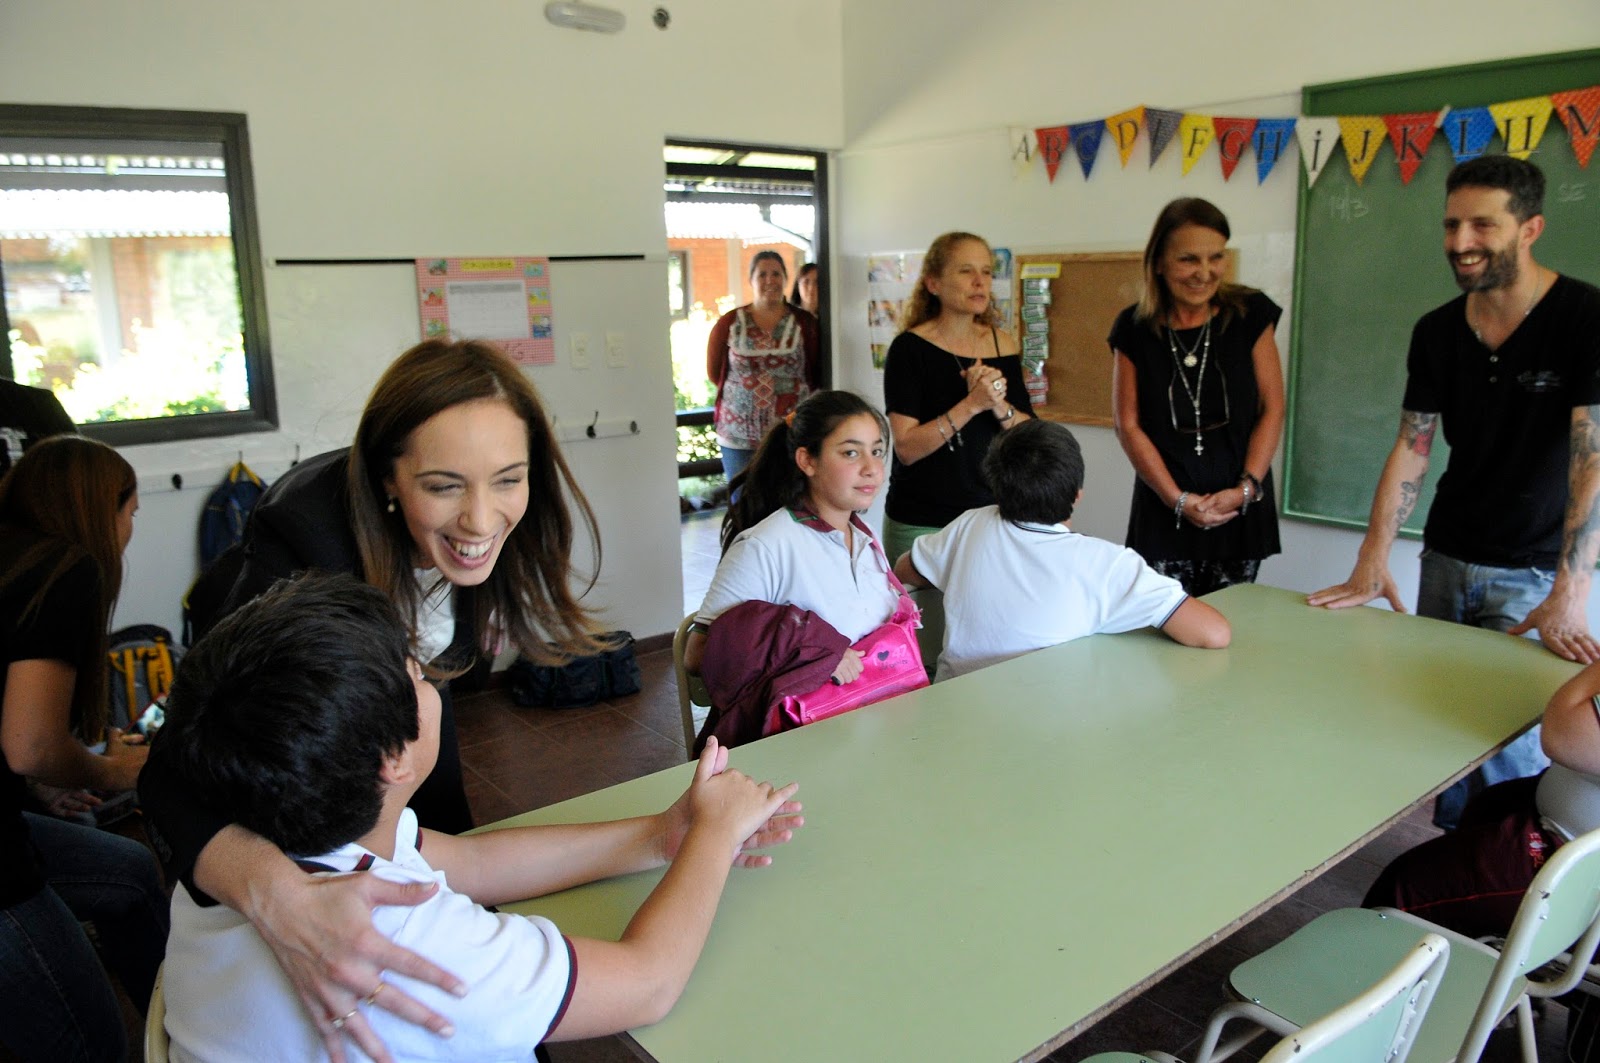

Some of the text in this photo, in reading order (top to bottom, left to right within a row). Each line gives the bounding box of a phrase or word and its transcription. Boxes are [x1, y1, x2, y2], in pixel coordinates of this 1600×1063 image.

[1012, 133, 1030, 163] A
[1044, 135, 1063, 165] B
[1076, 132, 1098, 163] C
[1117, 119, 1139, 151] D
[1187, 127, 1209, 158] F
[1219, 127, 1247, 161] G
[1353, 129, 1371, 165] J
[1396, 124, 1429, 163] K
